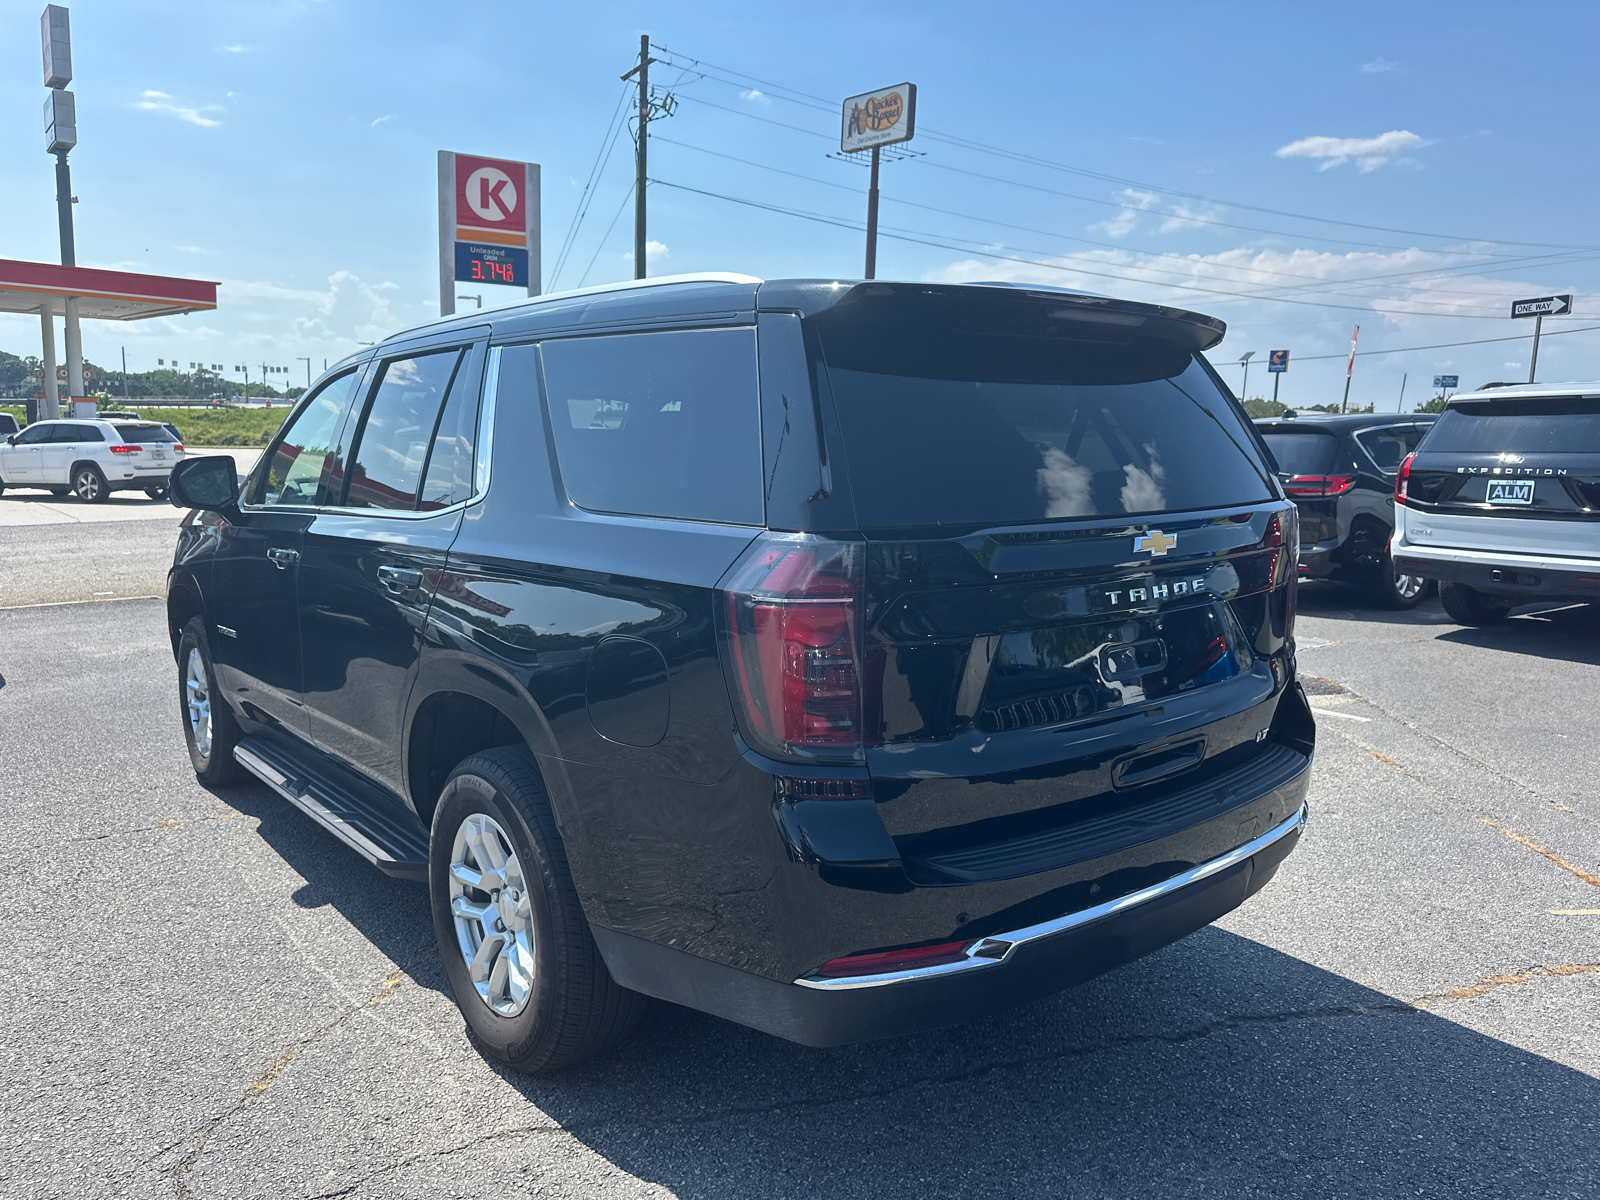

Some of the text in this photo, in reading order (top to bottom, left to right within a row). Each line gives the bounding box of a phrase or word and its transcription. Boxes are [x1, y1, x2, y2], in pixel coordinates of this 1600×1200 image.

[865, 135, 880, 143] Country
[480, 177, 512, 217] K
[470, 246, 505, 256] Unleaded
[1517, 302, 1552, 313] ONE WAY
[1457, 467, 1567, 475] EXPEDITION
[1491, 485, 1529, 499] ALM
[1105, 578, 1206, 605] TAHOE
